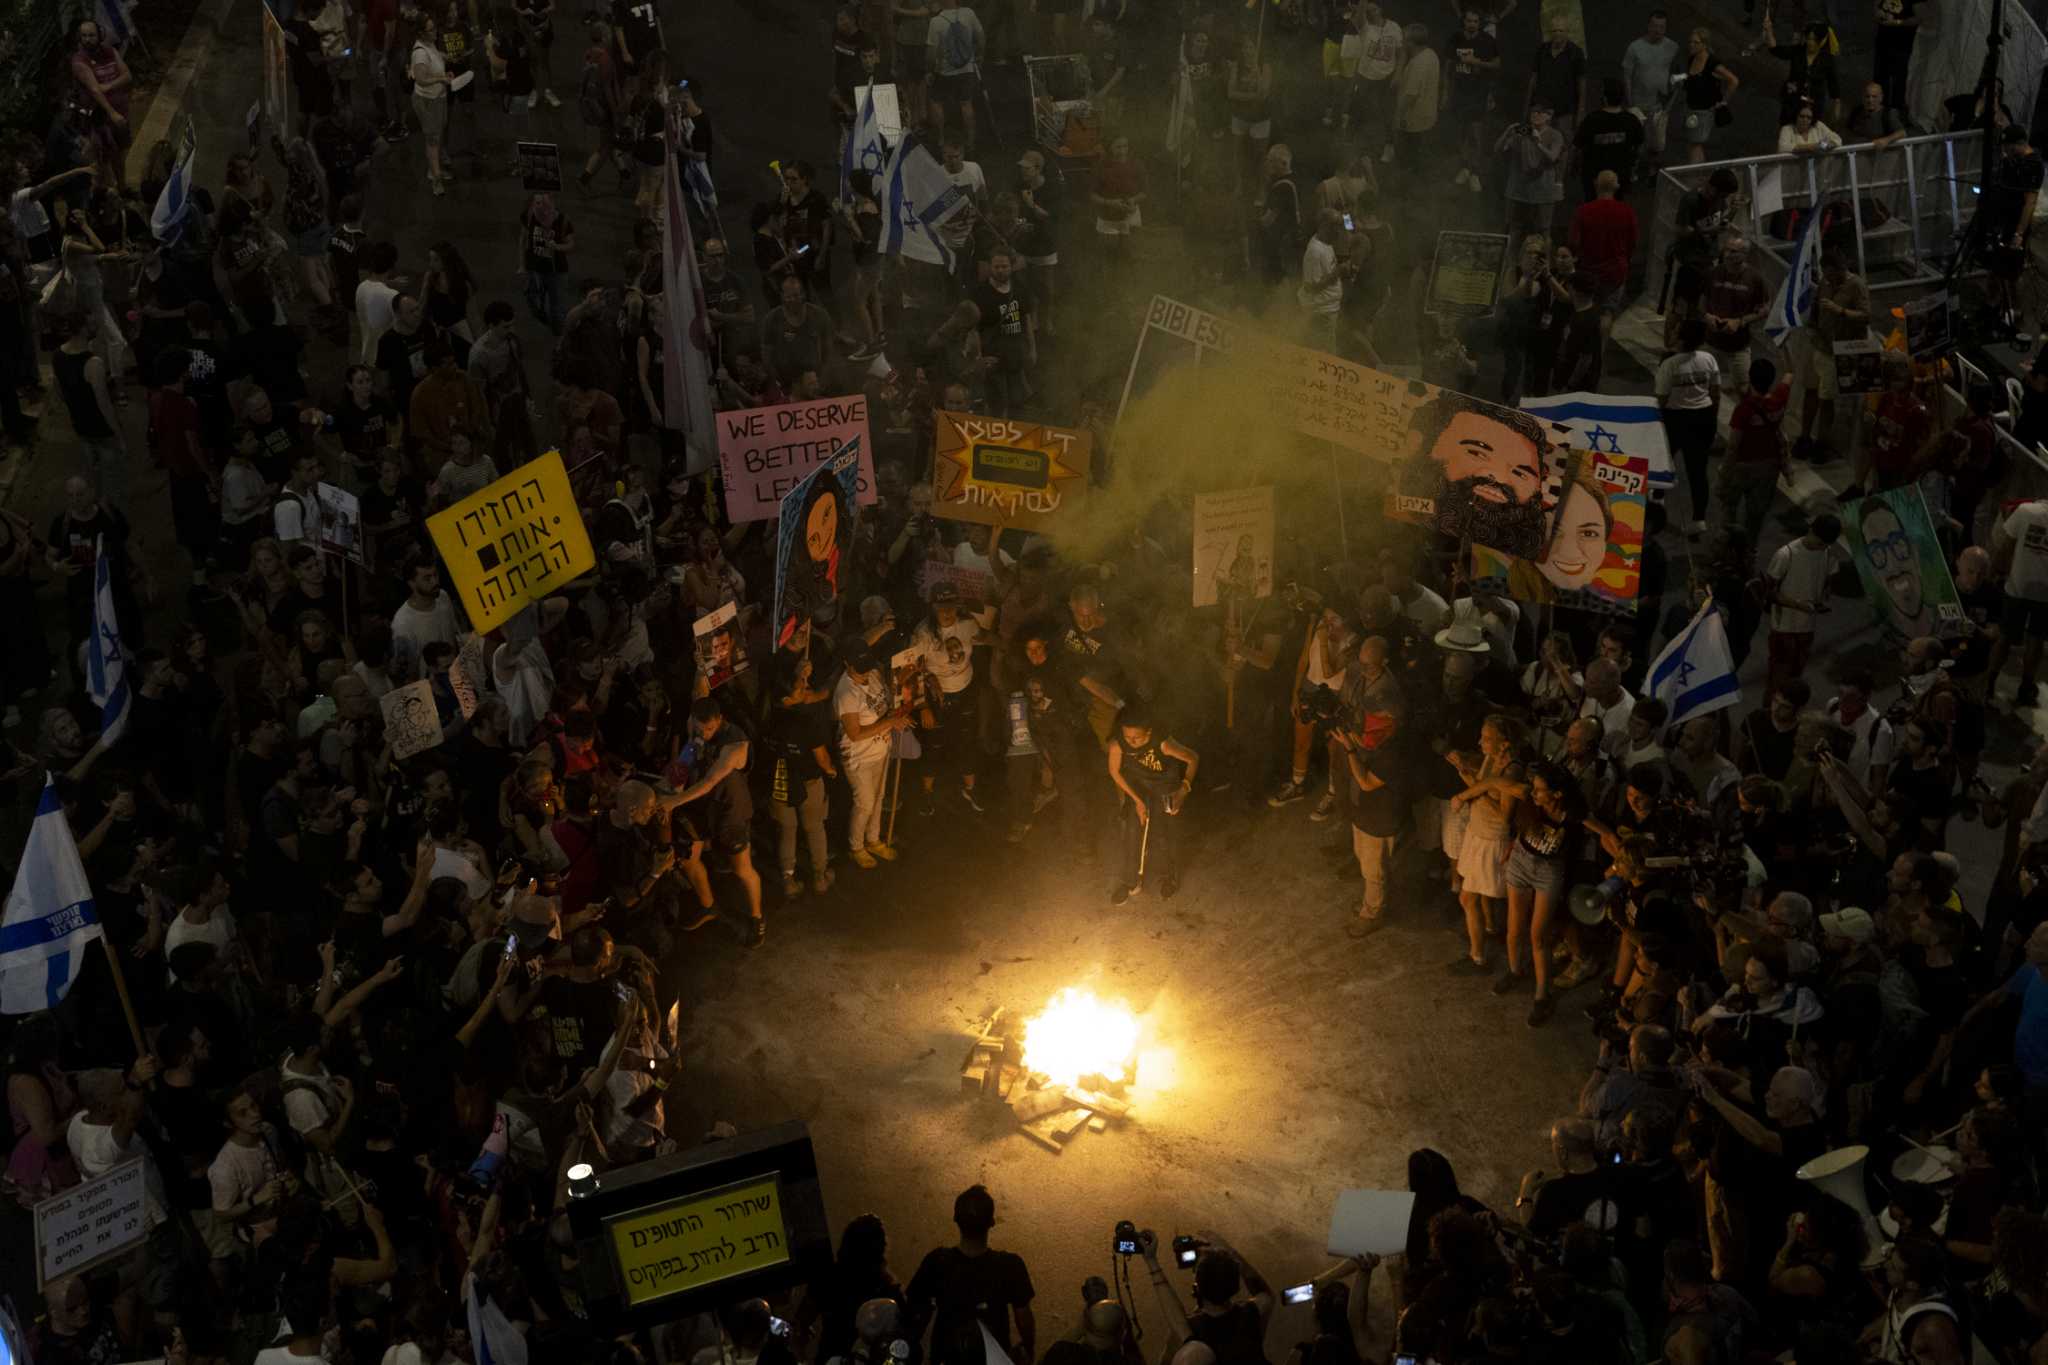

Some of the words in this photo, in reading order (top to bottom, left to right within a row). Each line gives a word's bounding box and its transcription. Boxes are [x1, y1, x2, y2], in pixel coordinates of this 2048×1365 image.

[1149, 299, 1192, 339] BIBI
[727, 414, 766, 440] WE
[777, 401, 866, 433] DESERVE
[954, 419, 1024, 447] לפוצץ
[1044, 429, 1078, 453] די
[1597, 467, 1641, 493] קרינה
[455, 478, 545, 547] החזירו
[955, 484, 1062, 518] עסקאות
[476, 540, 571, 616] הביתה!
[714, 1194, 771, 1222] שחרור
[629, 1213, 705, 1249] החטופים
[689, 1235, 737, 1273] להיות
[628, 1256, 689, 1288] בפוקוס
